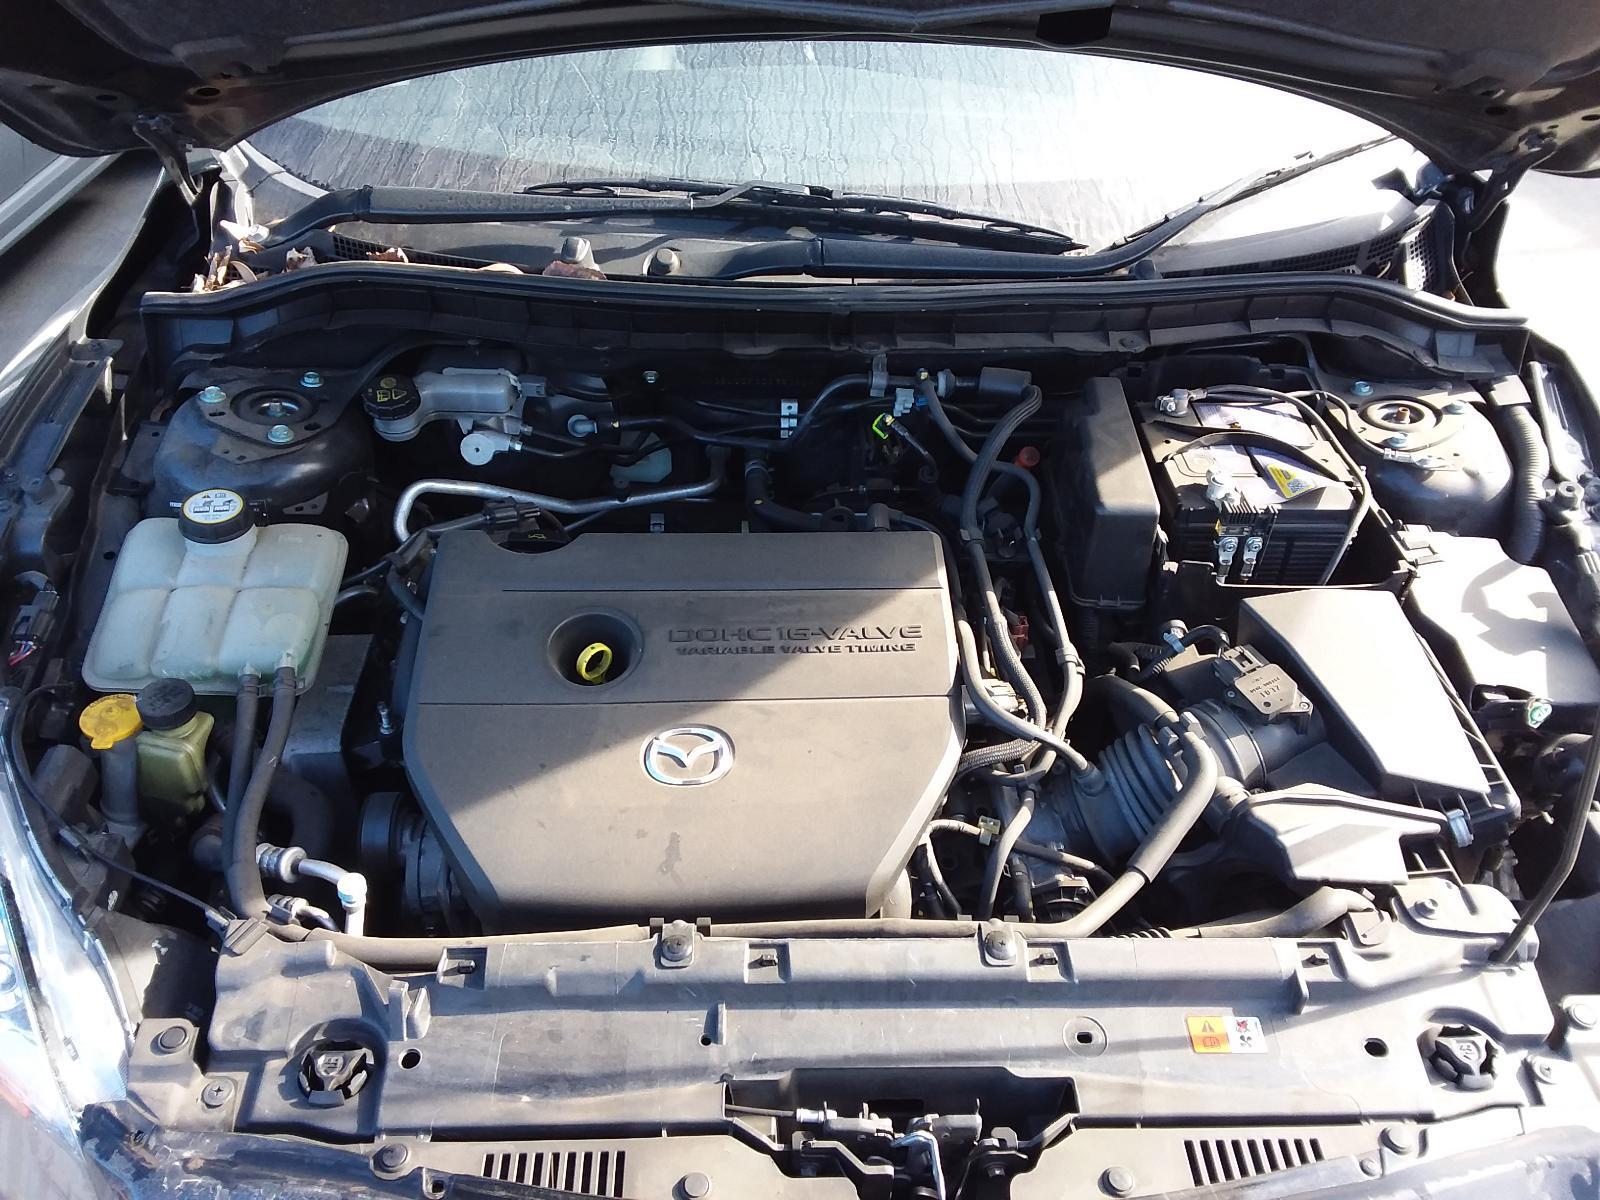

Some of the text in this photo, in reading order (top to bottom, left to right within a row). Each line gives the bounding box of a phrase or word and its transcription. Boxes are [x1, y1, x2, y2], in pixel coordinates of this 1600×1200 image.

[668, 625, 923, 643] DOHC 16-VALVE
[675, 643, 916, 656] VARIABLE VALVE TIMING
